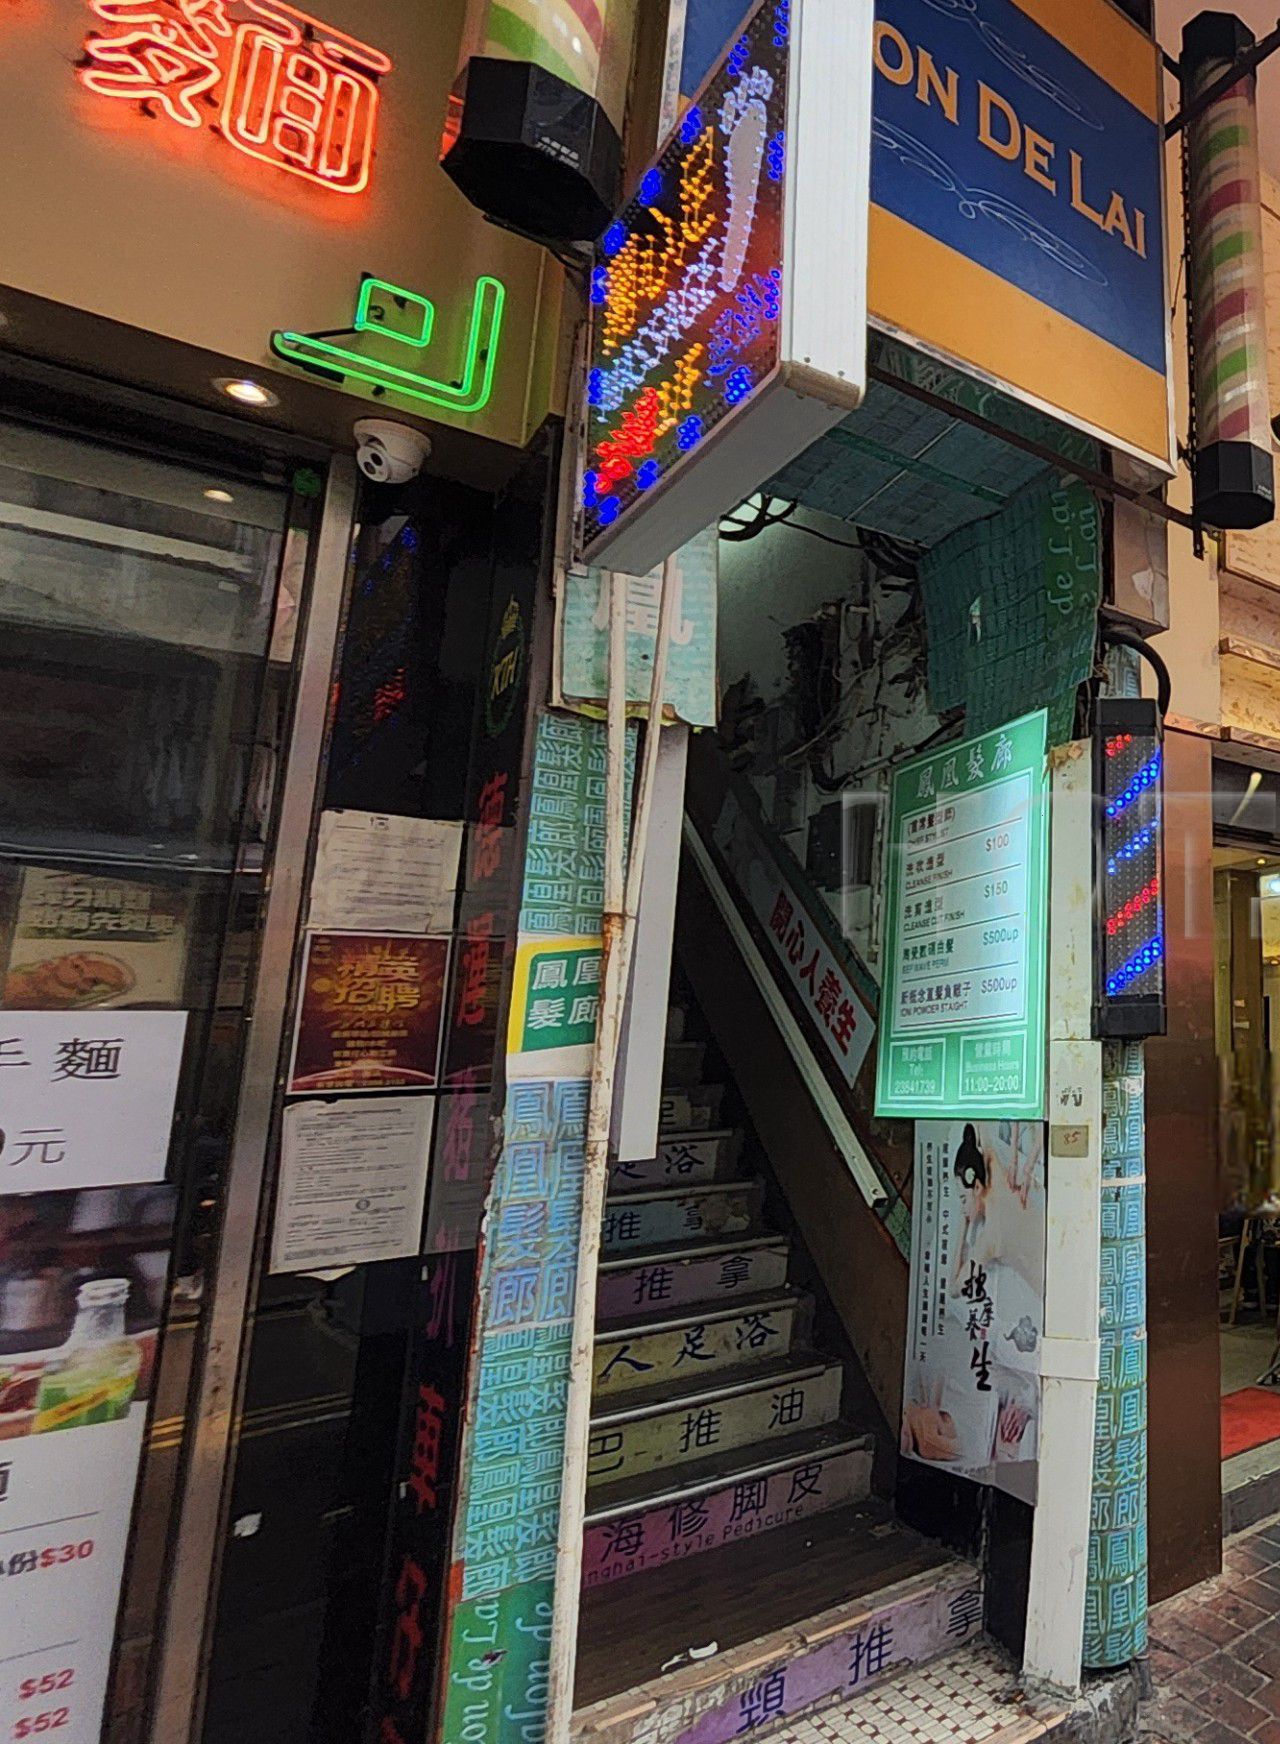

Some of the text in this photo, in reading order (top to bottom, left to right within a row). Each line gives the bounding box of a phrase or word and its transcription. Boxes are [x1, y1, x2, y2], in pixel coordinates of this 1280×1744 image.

[985, 833, 1010, 852] $100
[983, 880, 1009, 899] $150
[982, 927, 1020, 947] $500up
[980, 976, 1018, 995] $500up
[634, 1254, 754, 1305] 推拿
[722, 1504, 804, 1541] Pedicure
[18, 1667, 75, 1700] $52
[14, 1706, 70, 1740] $52
